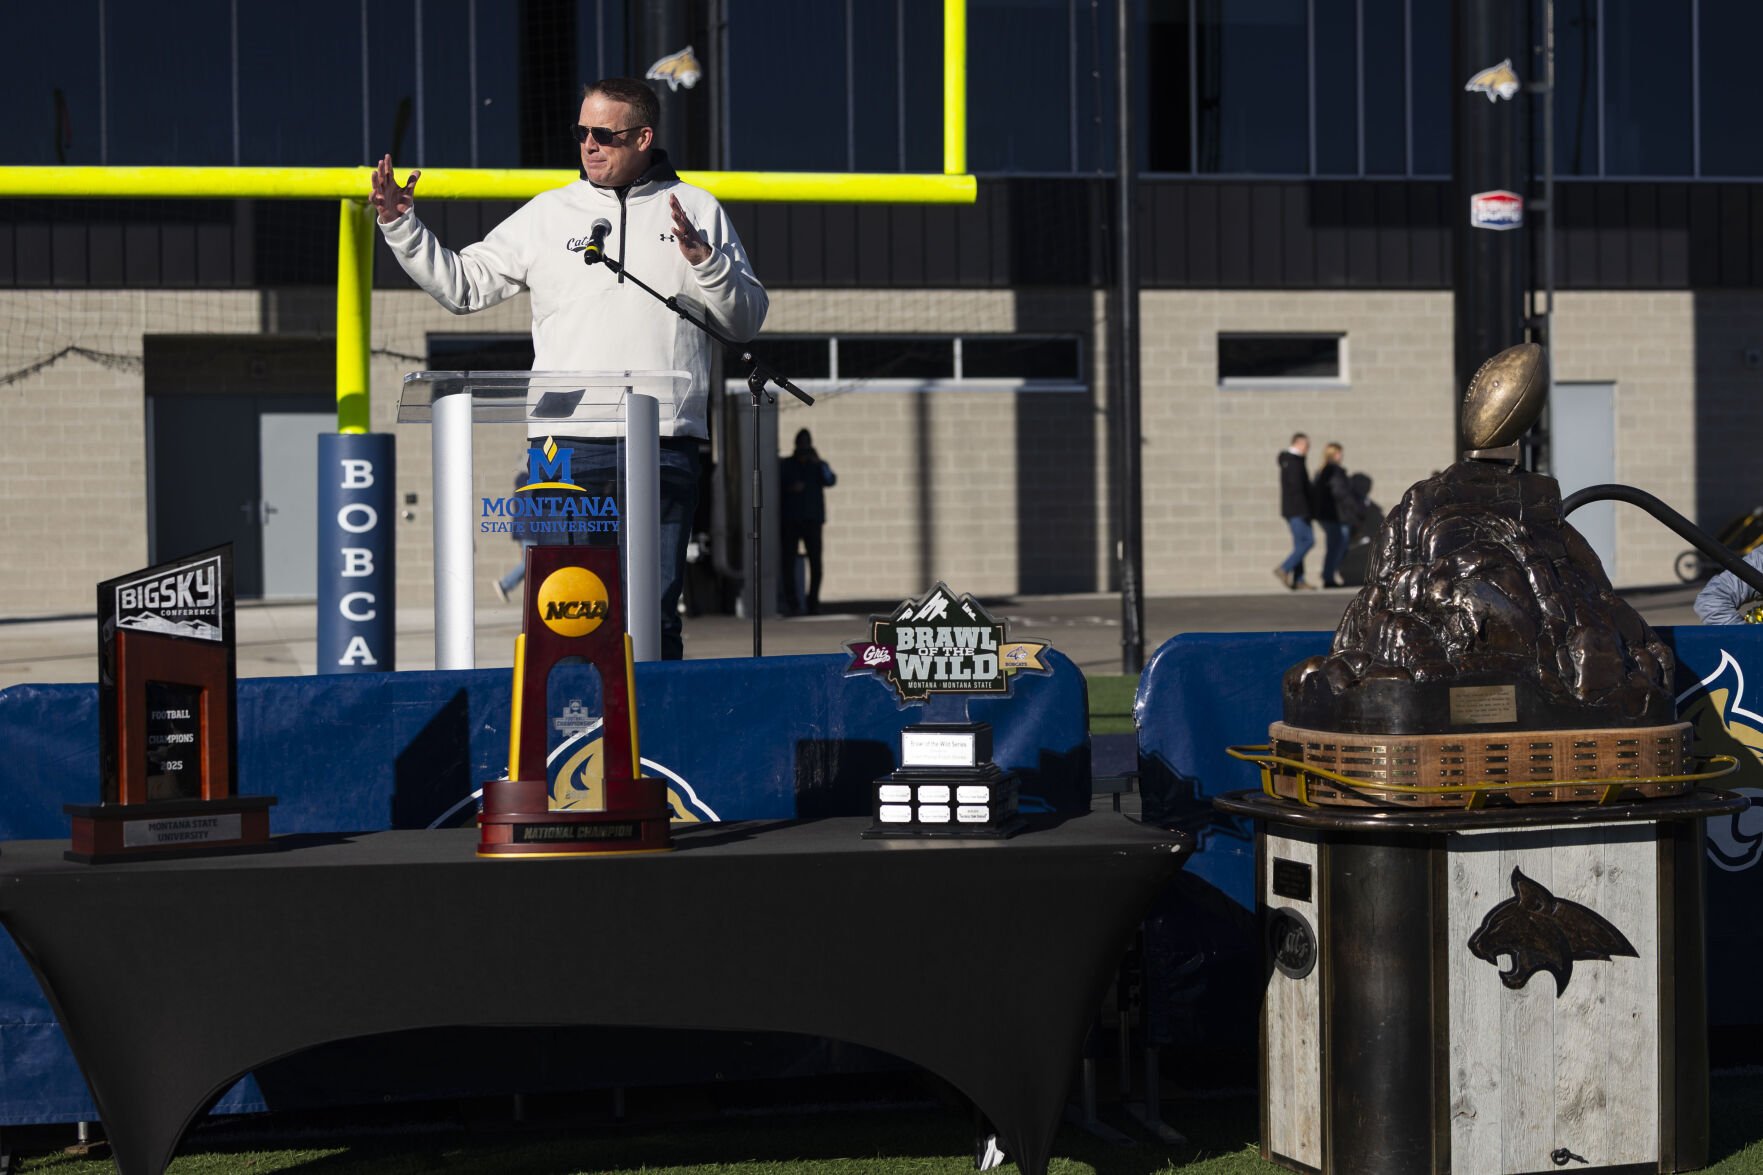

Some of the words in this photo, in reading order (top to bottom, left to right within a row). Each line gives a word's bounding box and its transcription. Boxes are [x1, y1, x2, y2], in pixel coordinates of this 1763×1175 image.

[481, 497, 619, 517] MONTANA
[481, 522, 525, 533] STATE
[530, 521, 620, 533] UNIVERSITY
[337, 459, 378, 665] BOBCA
[160, 608, 216, 617] CONFERENCE
[545, 601, 609, 621] NCAA
[896, 627, 997, 650] BRAWL
[863, 645, 891, 665] Griz
[918, 648, 939, 656] OF
[943, 648, 974, 656] THE
[896, 653, 998, 680] WILD
[152, 709, 191, 720] FOOTBALL
[149, 733, 194, 744] CHAMPIONS
[160, 760, 183, 771] 2025
[148, 821, 191, 832] MONTANA
[192, 818, 218, 828] STATE
[157, 831, 208, 842] UNIVERSITY
[523, 826, 575, 840] NATIONAL
[577, 825, 633, 838] CHAMPION
